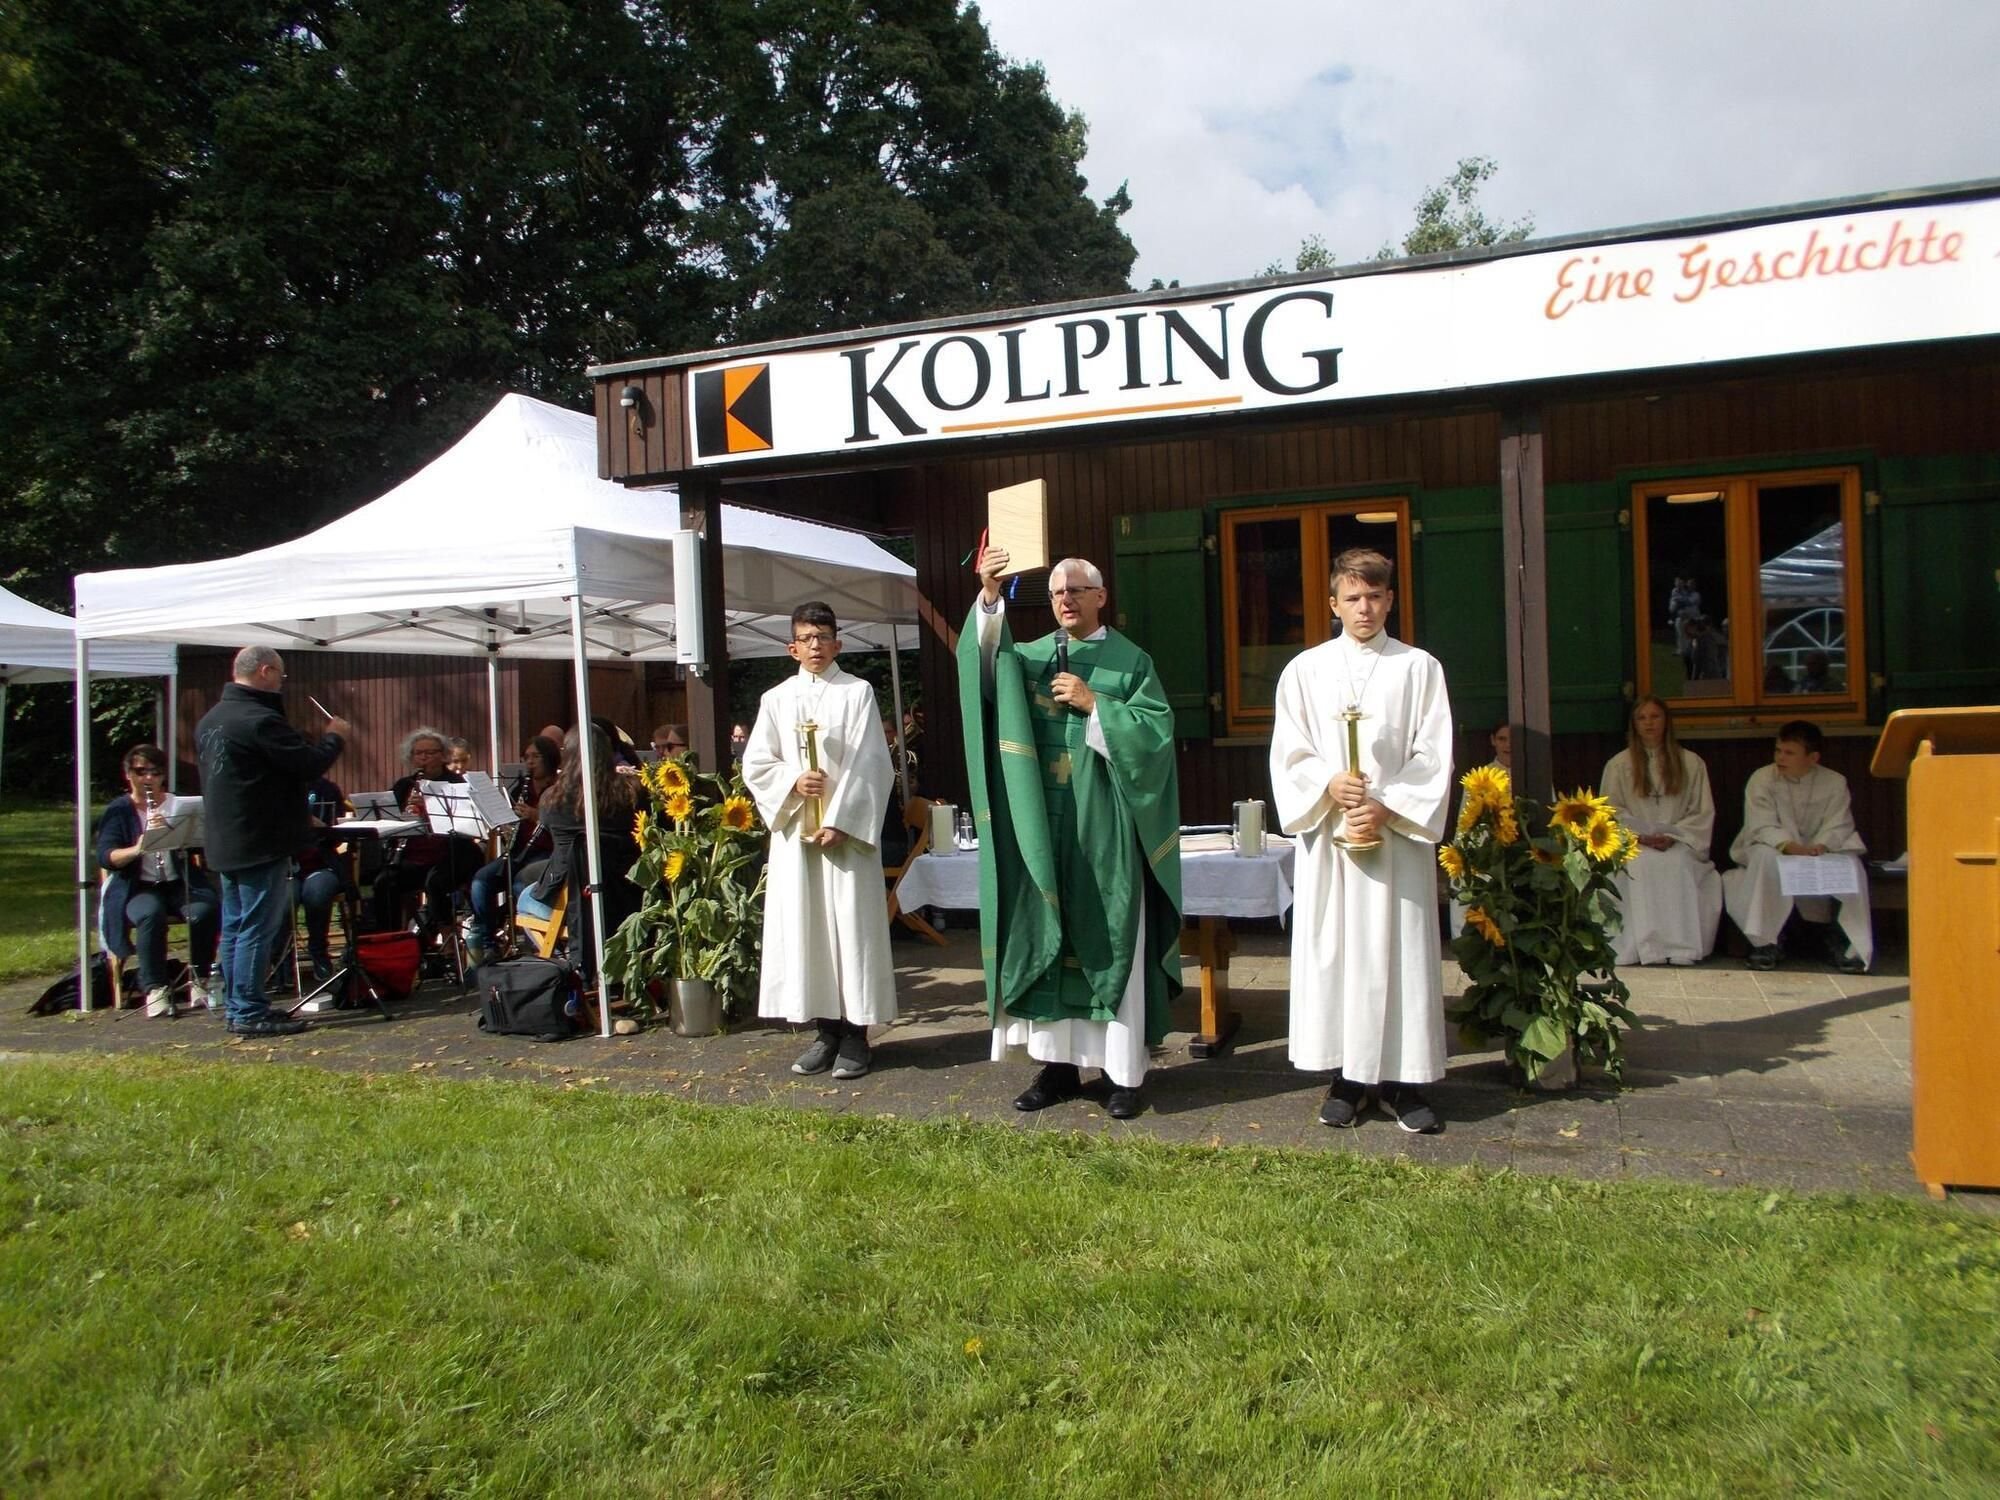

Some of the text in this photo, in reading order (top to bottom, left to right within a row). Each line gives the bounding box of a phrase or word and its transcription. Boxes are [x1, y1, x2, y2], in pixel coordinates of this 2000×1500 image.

[1544, 221, 1964, 320] Eine Geschichte
[840, 291, 1343, 443] KOLPING
